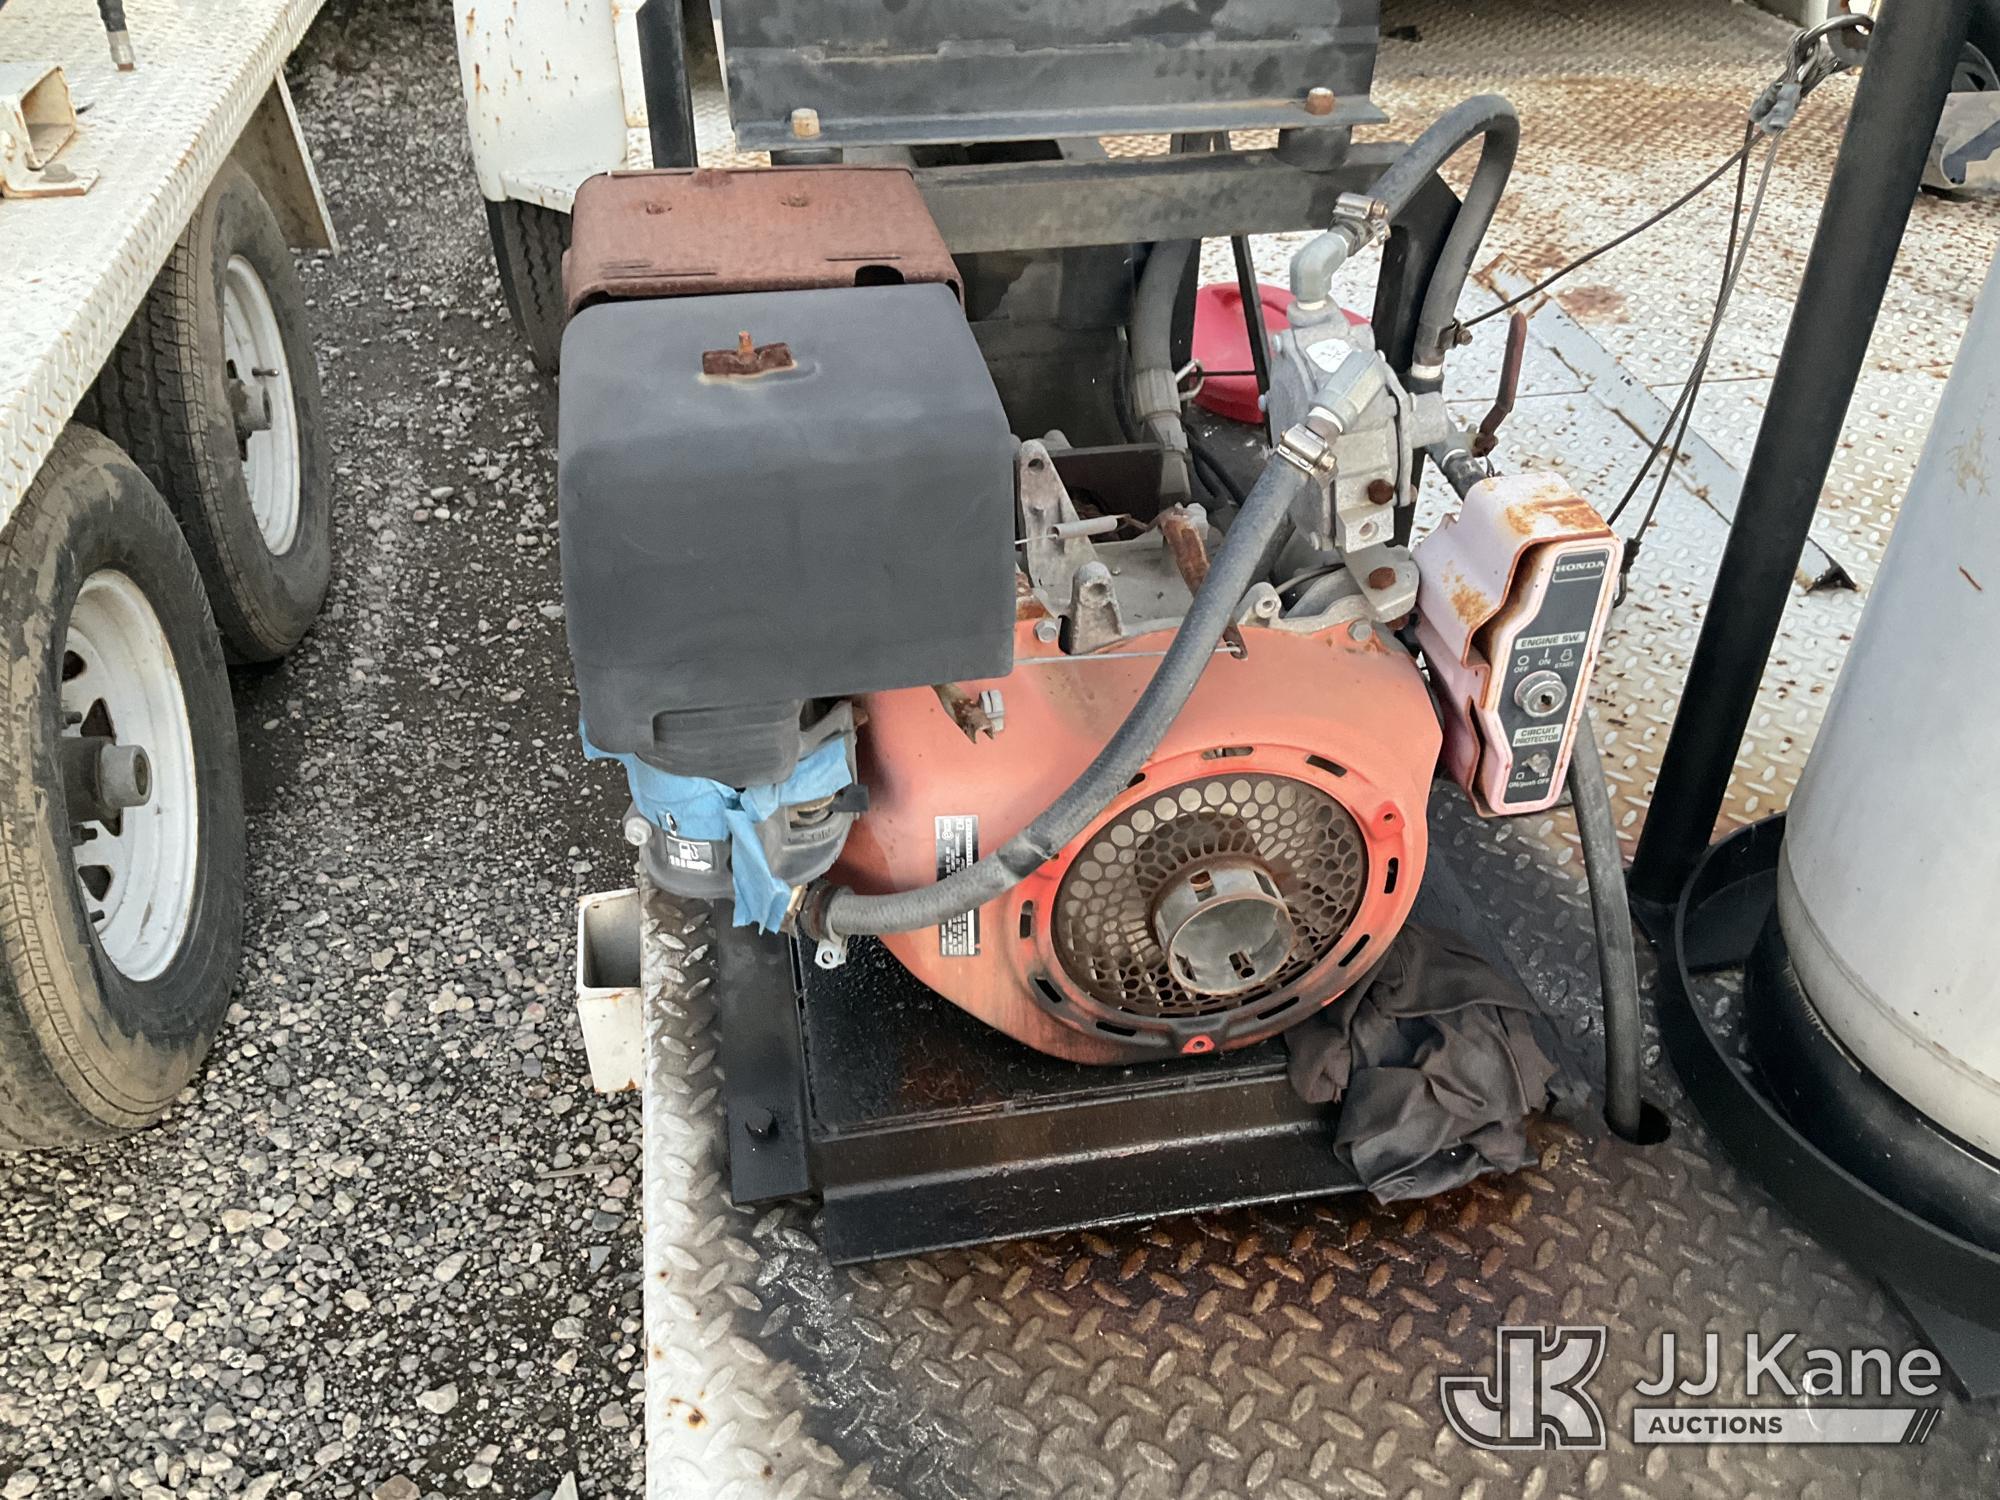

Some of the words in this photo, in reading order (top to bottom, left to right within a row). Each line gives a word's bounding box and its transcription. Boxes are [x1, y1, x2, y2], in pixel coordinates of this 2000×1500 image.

[1556, 560, 1605, 572] HONDA
[1521, 636, 1559, 647] ENGINE
[1555, 661, 1574, 669] START
[1521, 727, 1557, 736] CIRCUIT
[1515, 734, 1558, 744] PROTECTOR
